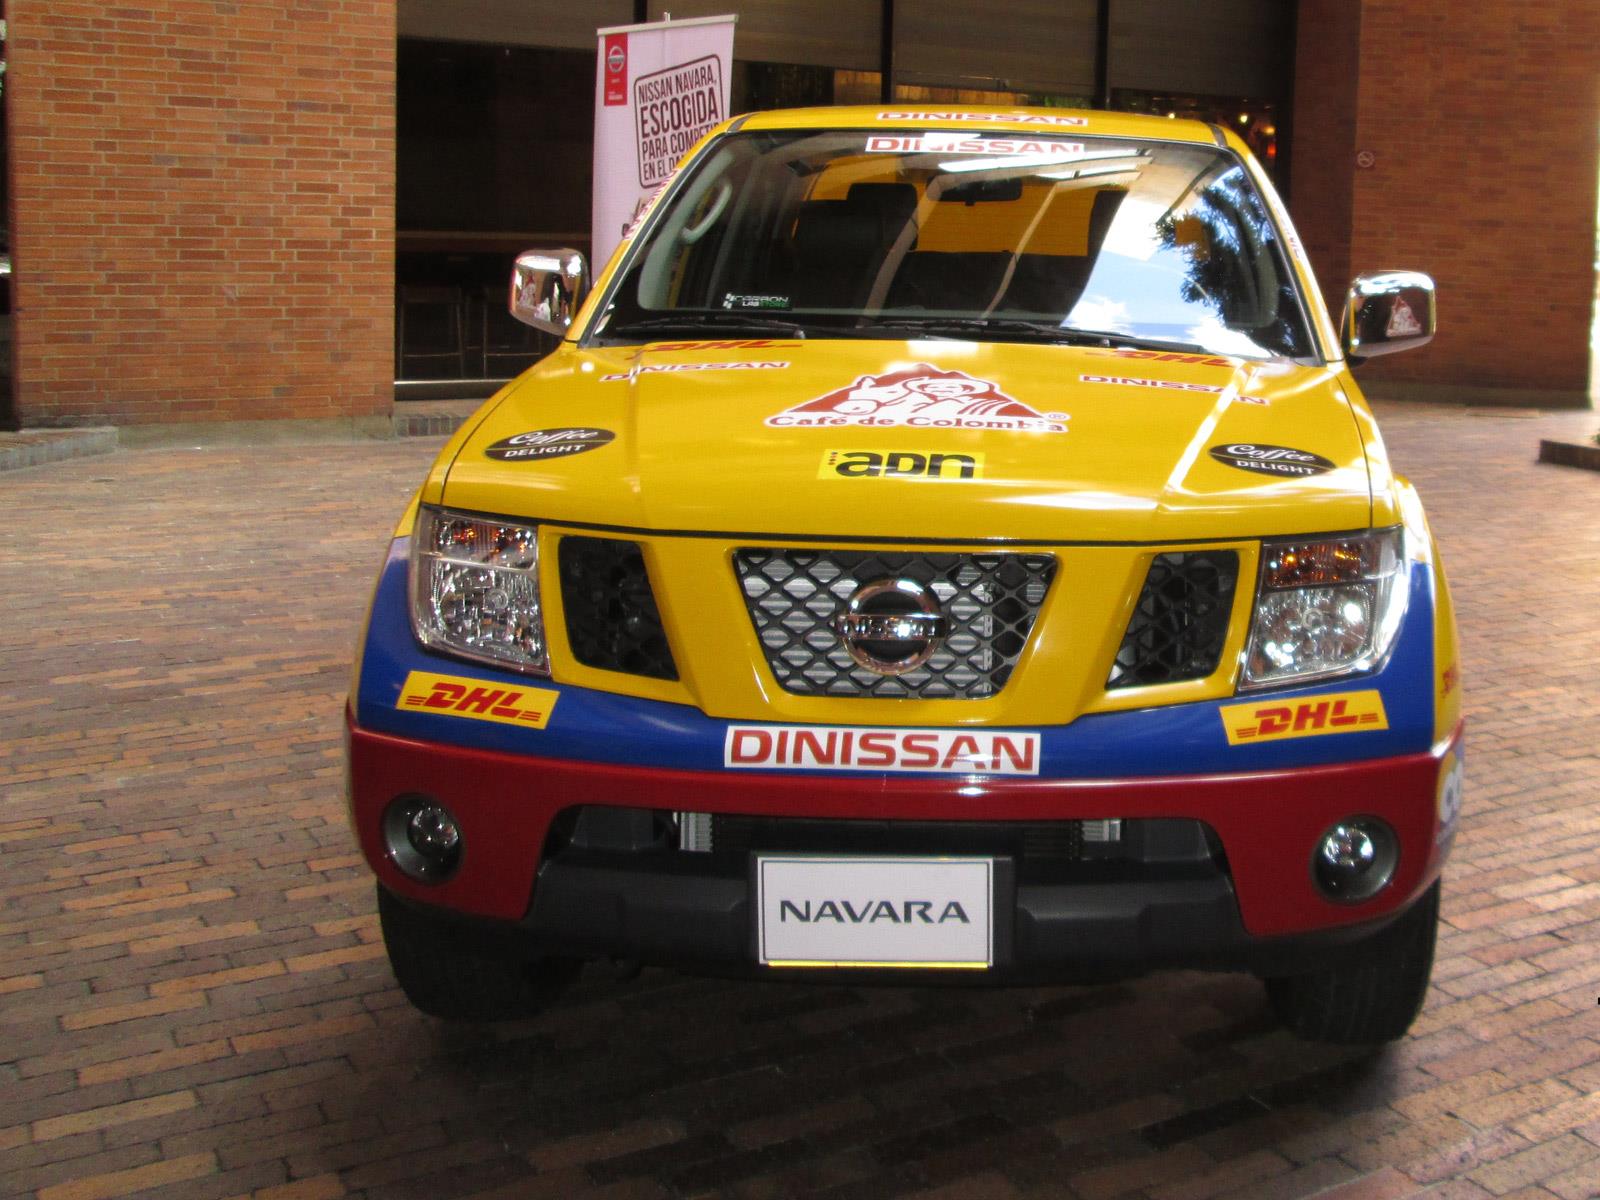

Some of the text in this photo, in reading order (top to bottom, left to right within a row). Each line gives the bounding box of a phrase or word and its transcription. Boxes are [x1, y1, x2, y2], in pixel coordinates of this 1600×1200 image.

[638, 64, 717, 104] NISSAN NAVARA,
[640, 86, 719, 139] ESCOGIDA
[880, 112, 1085, 125] DINISSAN
[642, 122, 719, 161] PARA COMPET
[643, 161, 656, 181] EN
[657, 160, 667, 178] EL
[769, 415, 848, 427] Café
[857, 416, 895, 427] de
[504, 444, 586, 458] DELIGHT
[1226, 444, 1316, 461] Coffee
[1235, 460, 1315, 475] DELIGHT
[423, 682, 524, 718] DHL
[1255, 699, 1359, 736] DHL
[730, 729, 1035, 772] DINISSAN
[780, 899, 971, 924] NAVARA
